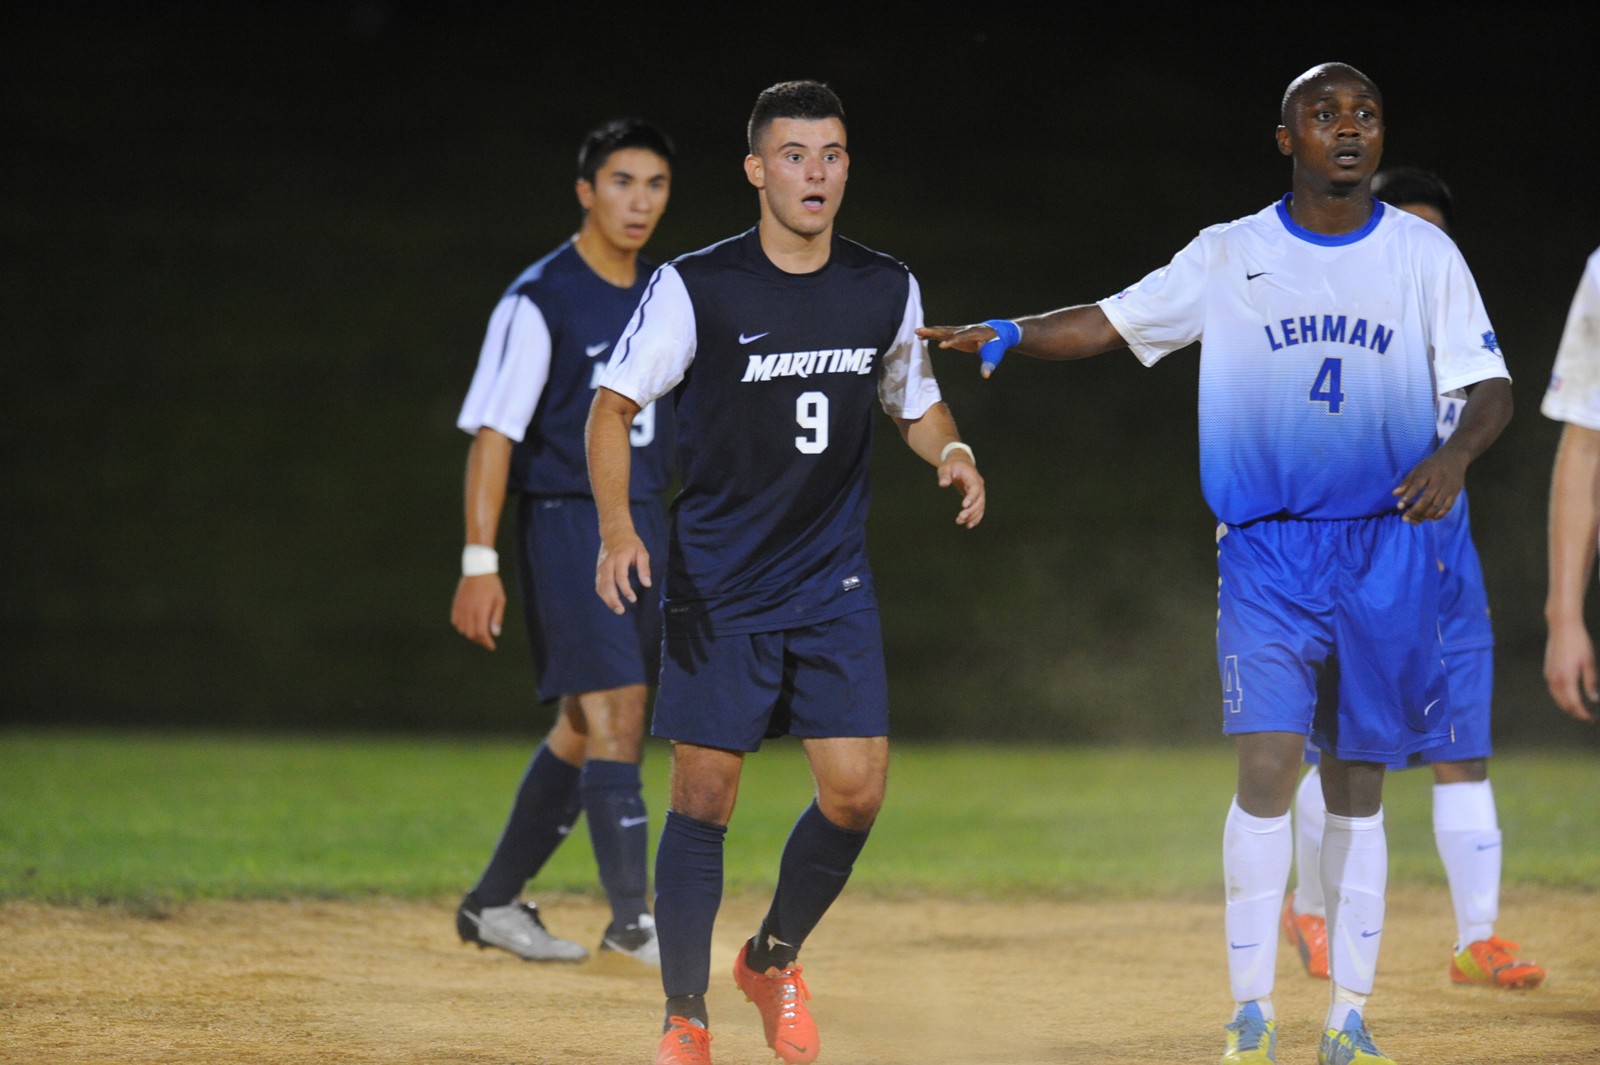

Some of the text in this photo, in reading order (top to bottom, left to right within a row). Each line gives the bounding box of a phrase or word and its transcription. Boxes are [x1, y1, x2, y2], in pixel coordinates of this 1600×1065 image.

[1264, 314, 1394, 354] LEHMAN
[741, 348, 877, 383] MARITIME
[1309, 356, 1346, 416] 4
[795, 391, 829, 455] 9
[1222, 655, 1242, 713] 4
